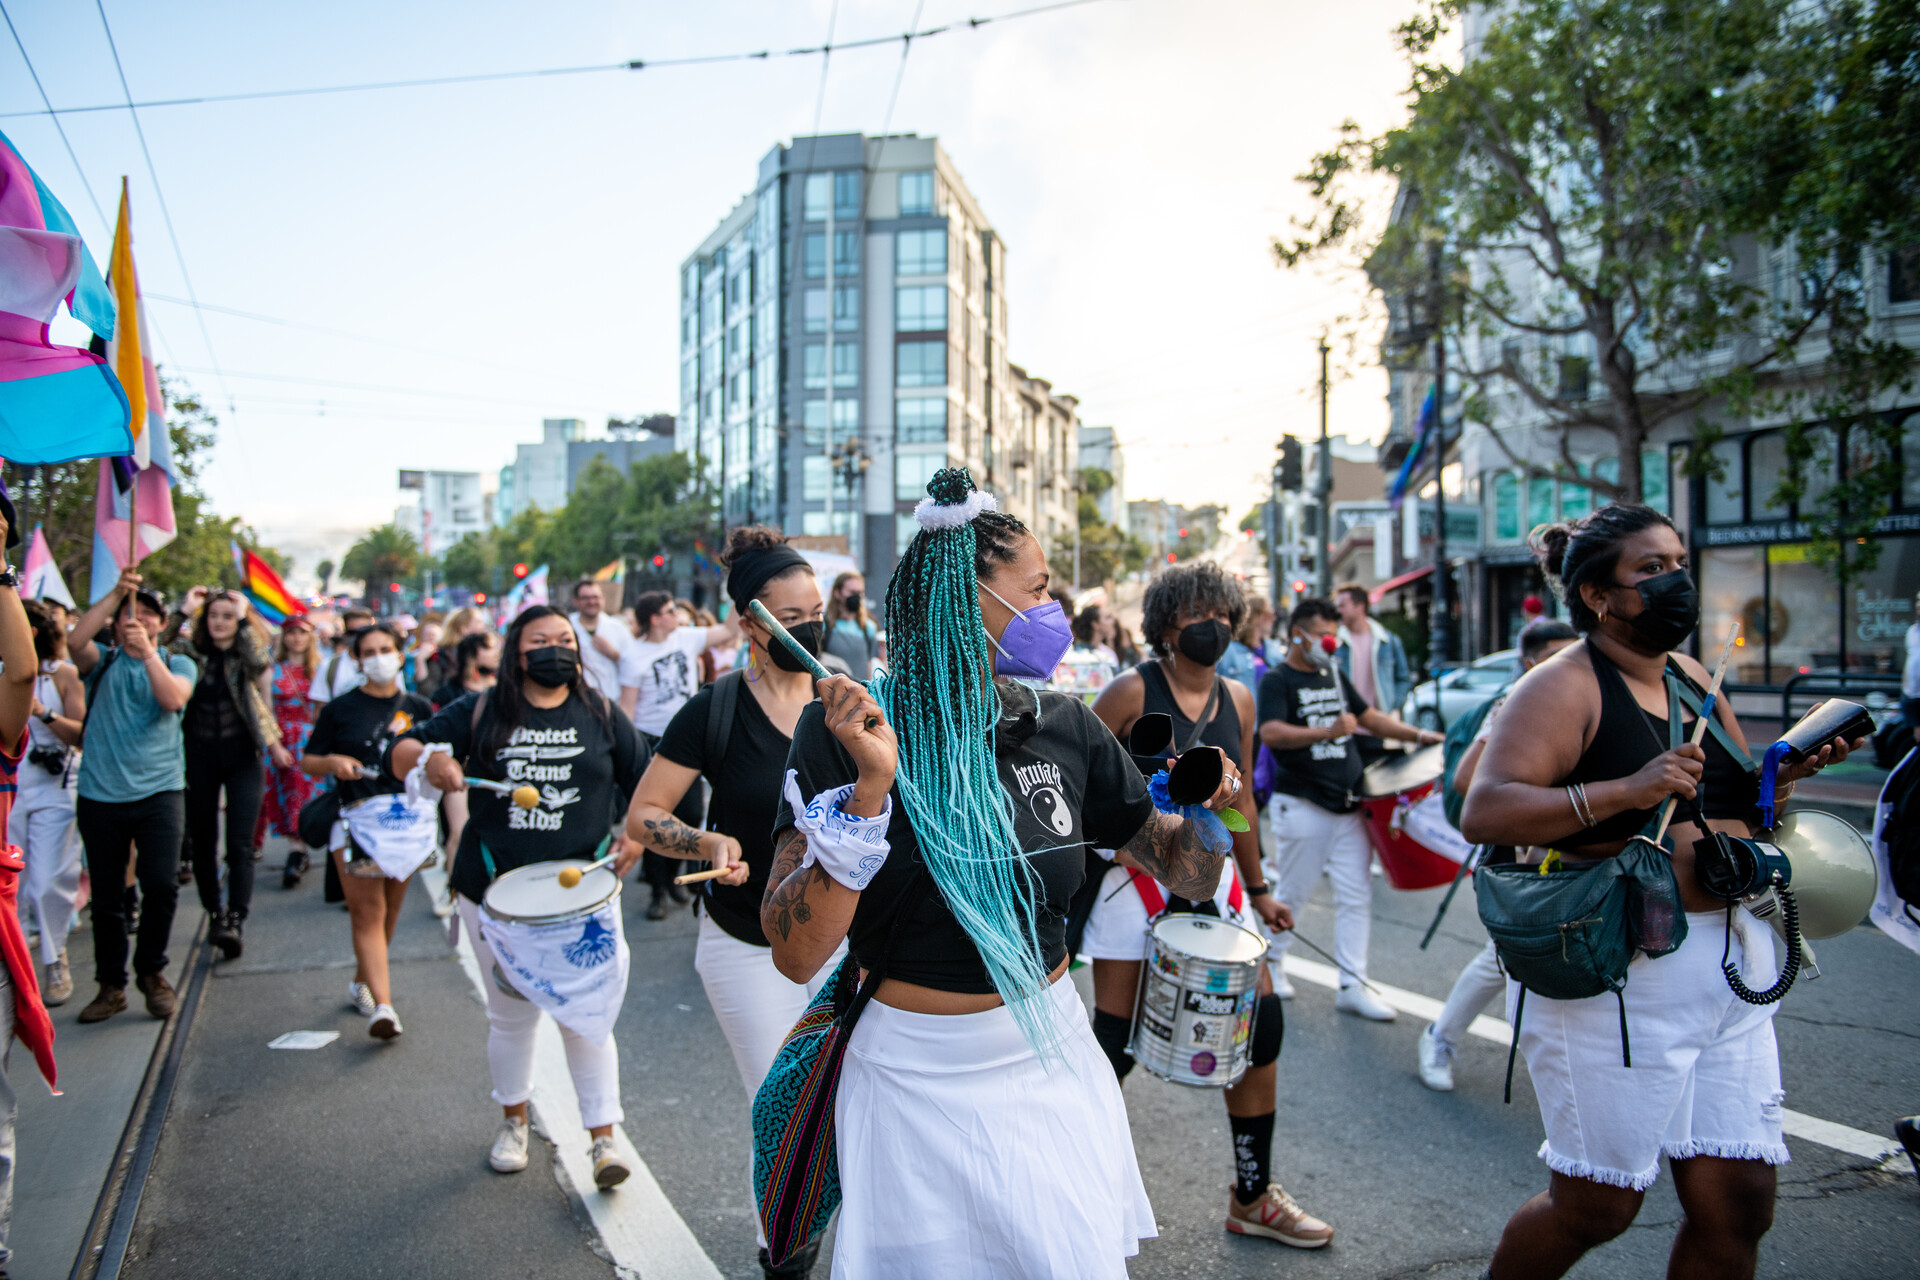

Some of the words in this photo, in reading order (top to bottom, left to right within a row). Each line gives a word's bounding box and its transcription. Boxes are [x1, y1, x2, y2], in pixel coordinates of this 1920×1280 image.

[1708, 525, 1776, 544] BEDROOM
[1778, 523, 1793, 539] &
[508, 726, 578, 746] Protect
[506, 760, 573, 782] Trans
[508, 807, 565, 831] Kids
